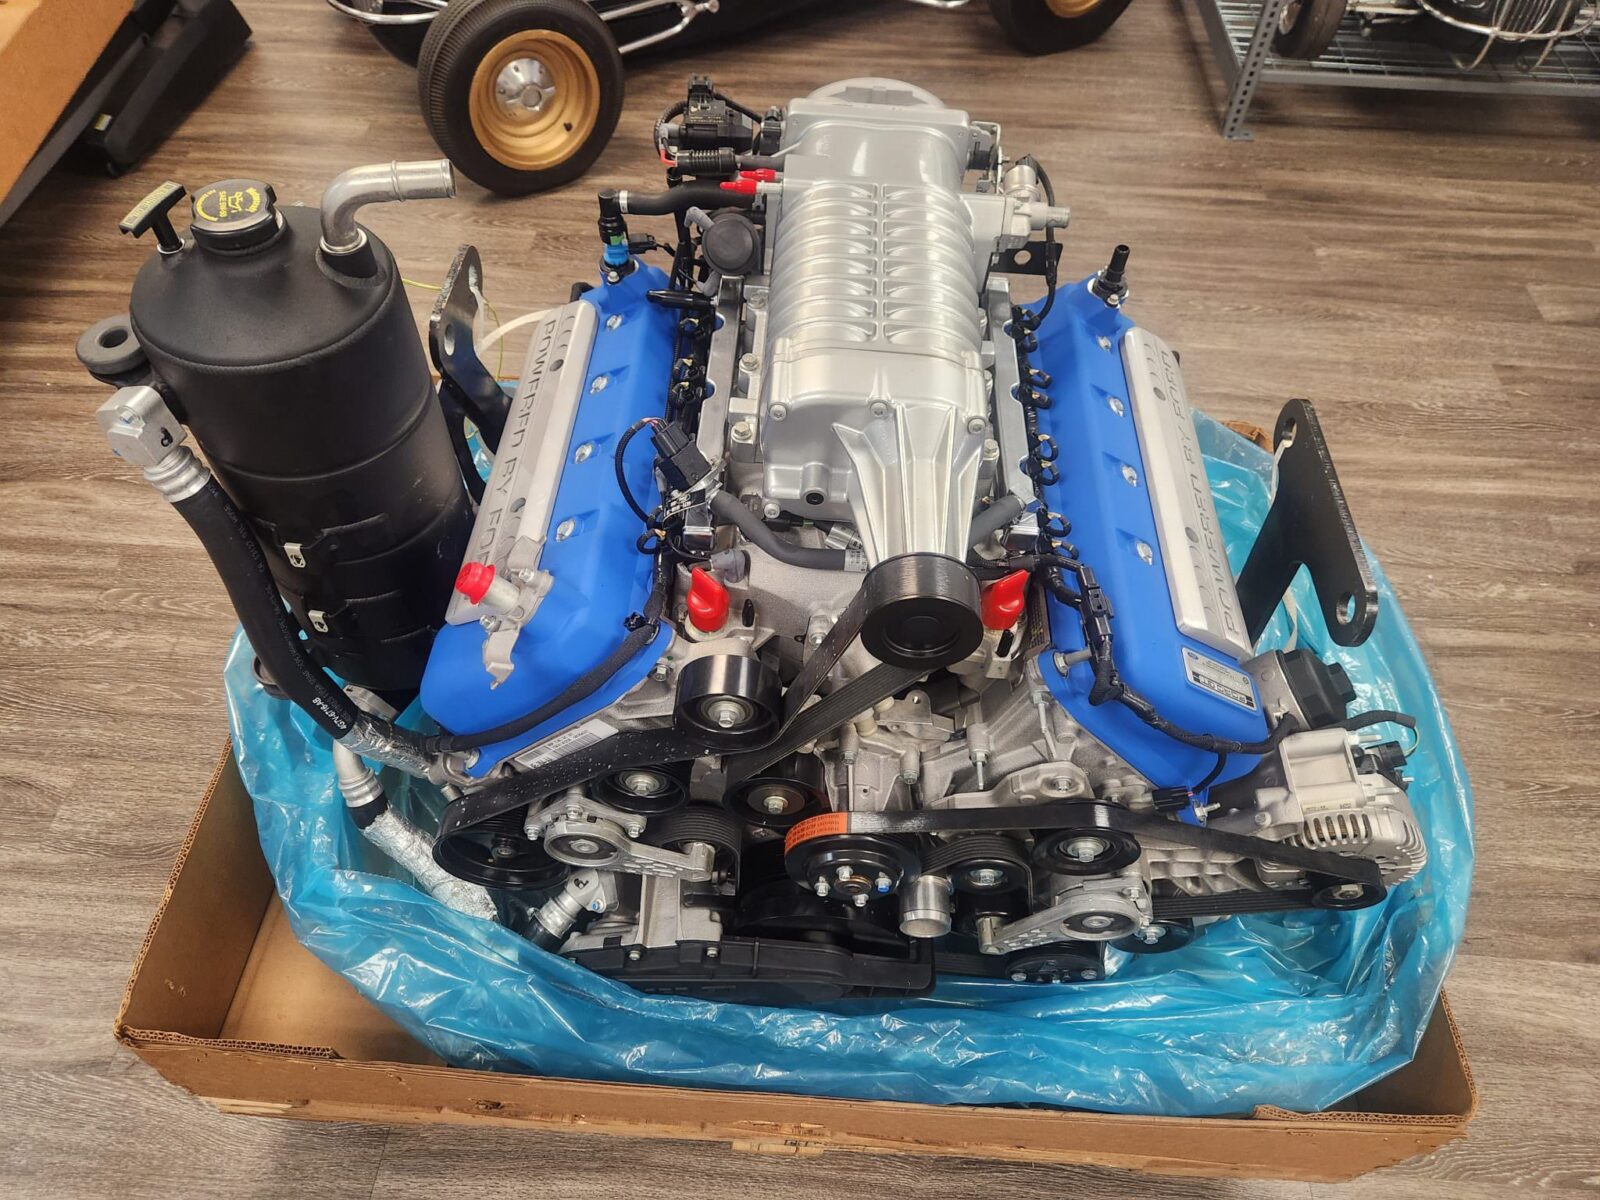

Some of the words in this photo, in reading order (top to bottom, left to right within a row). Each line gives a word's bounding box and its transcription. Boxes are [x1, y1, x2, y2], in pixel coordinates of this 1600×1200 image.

[511, 319, 557, 448] POWERED
[1161, 350, 1186, 421] FORD
[496, 457, 518, 495] BY
[1178, 425, 1196, 464] BY
[1190, 473, 1239, 635] POWERED
